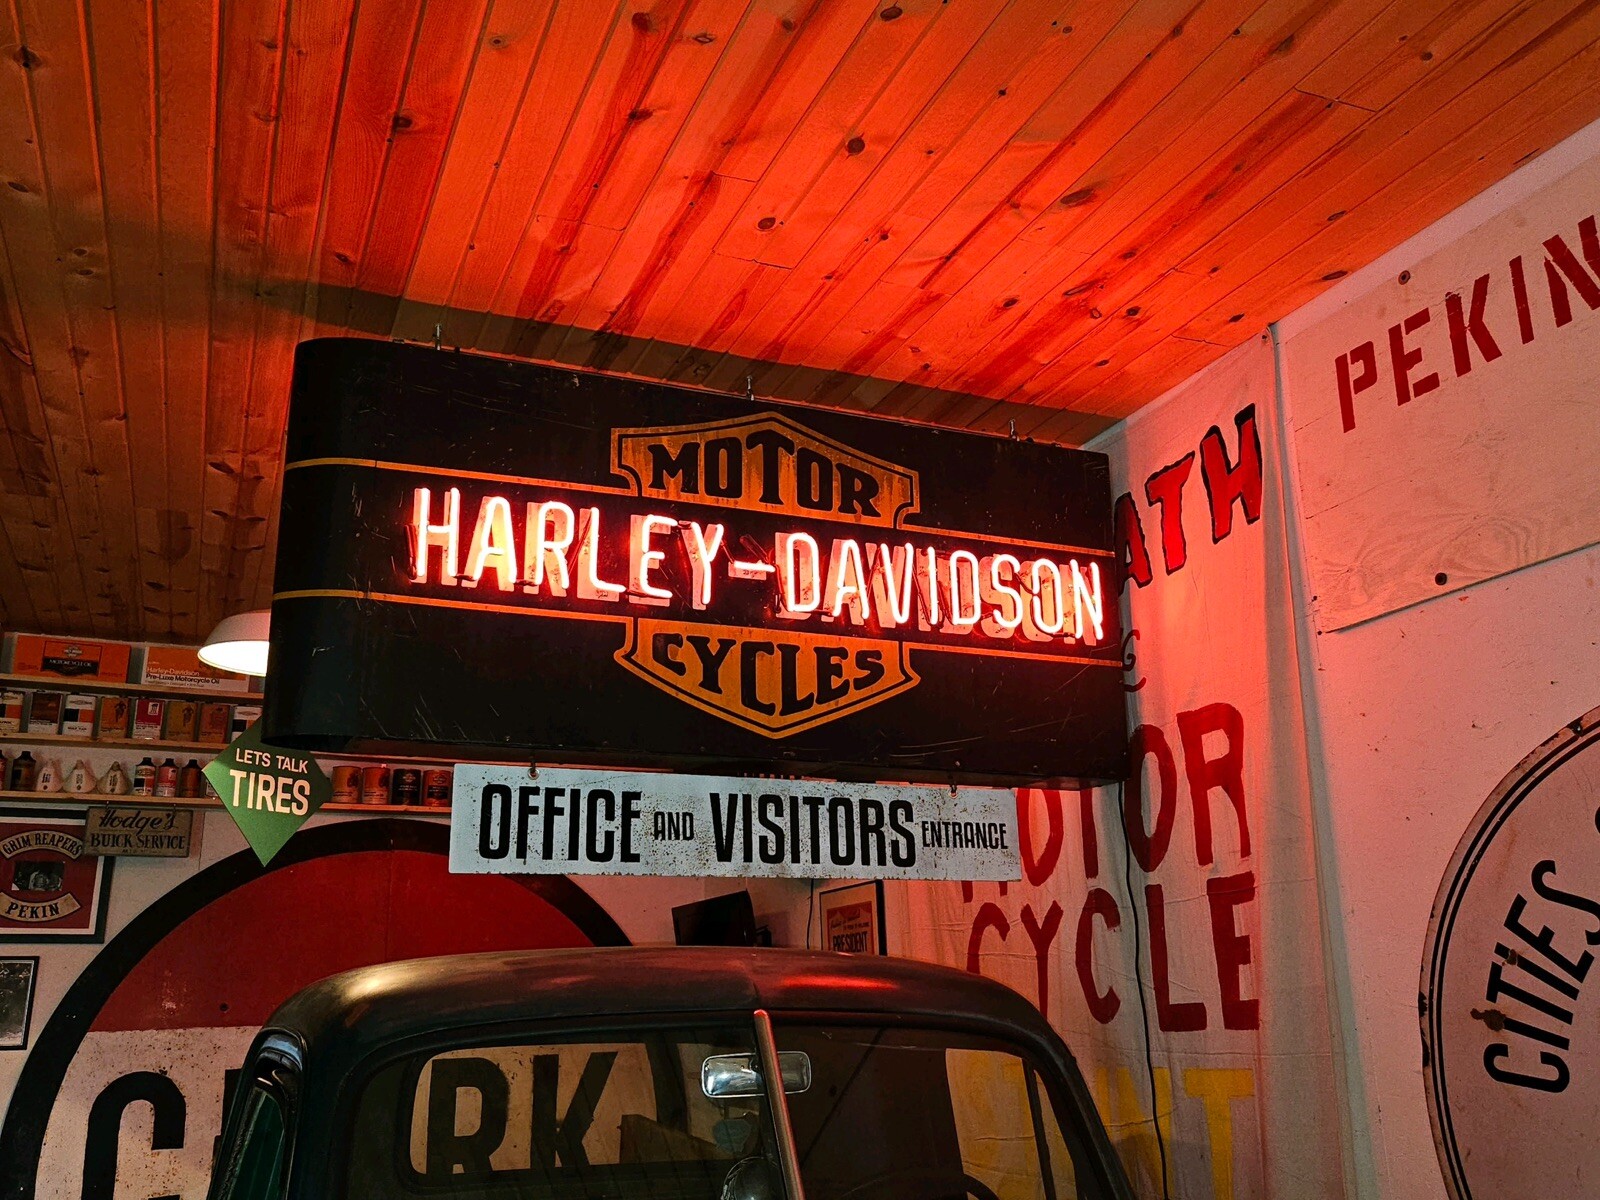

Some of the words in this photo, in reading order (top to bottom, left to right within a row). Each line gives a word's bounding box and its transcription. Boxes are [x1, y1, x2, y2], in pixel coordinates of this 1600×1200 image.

[1335, 215, 1600, 433] PEKIN
[646, 429, 881, 518] MOTOR
[406, 486, 1105, 647] HARLEY-DAVIDSON
[147, 666, 200, 676] Harley-Davidson
[175, 675, 210, 684] Motorcycle
[651, 633, 884, 716] CYCLES
[235, 748, 271, 767] LETS
[276, 755, 308, 774] TALK
[229, 769, 311, 816] TIRES
[91, 833, 133, 848] BUICK
[136, 834, 186, 850] SERVICE
[99, 808, 179, 837] Hodge's
[478, 784, 642, 863] OFFICE
[653, 811, 695, 841] AND
[709, 792, 917, 867] VISITORS
[922, 820, 1009, 850] ENTRANCE
[2, 833, 32, 855] GRIM
[34, 832, 83, 856] REAPERS
[5, 902, 60, 919] PEKIN
[832, 931, 868, 952] PRESIDENT
[966, 871, 1260, 1033] CYCLE
[1483, 859, 1600, 1094] CITIES
